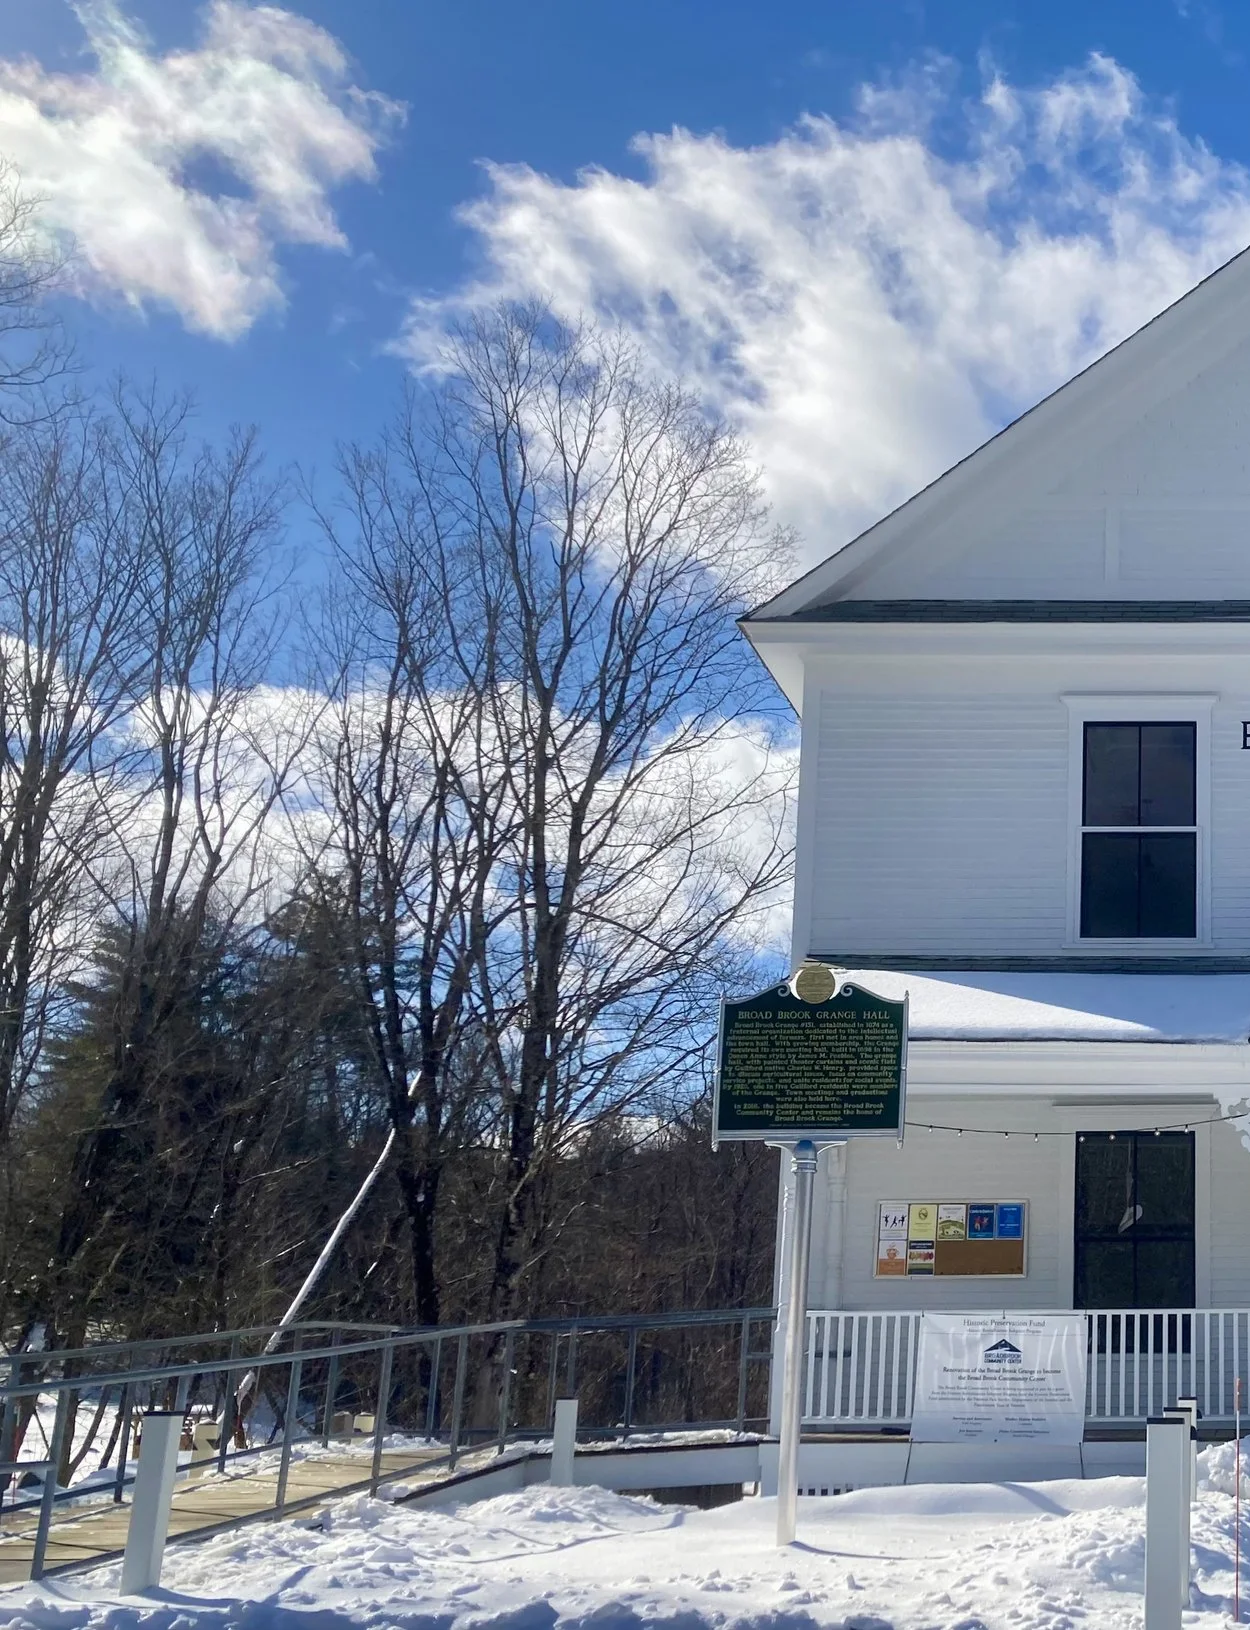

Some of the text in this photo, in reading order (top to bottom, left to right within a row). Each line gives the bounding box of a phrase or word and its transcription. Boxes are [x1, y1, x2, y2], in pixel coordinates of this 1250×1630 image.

[738, 1011, 889, 1019] BROAD BROOK GRANGE HALL
